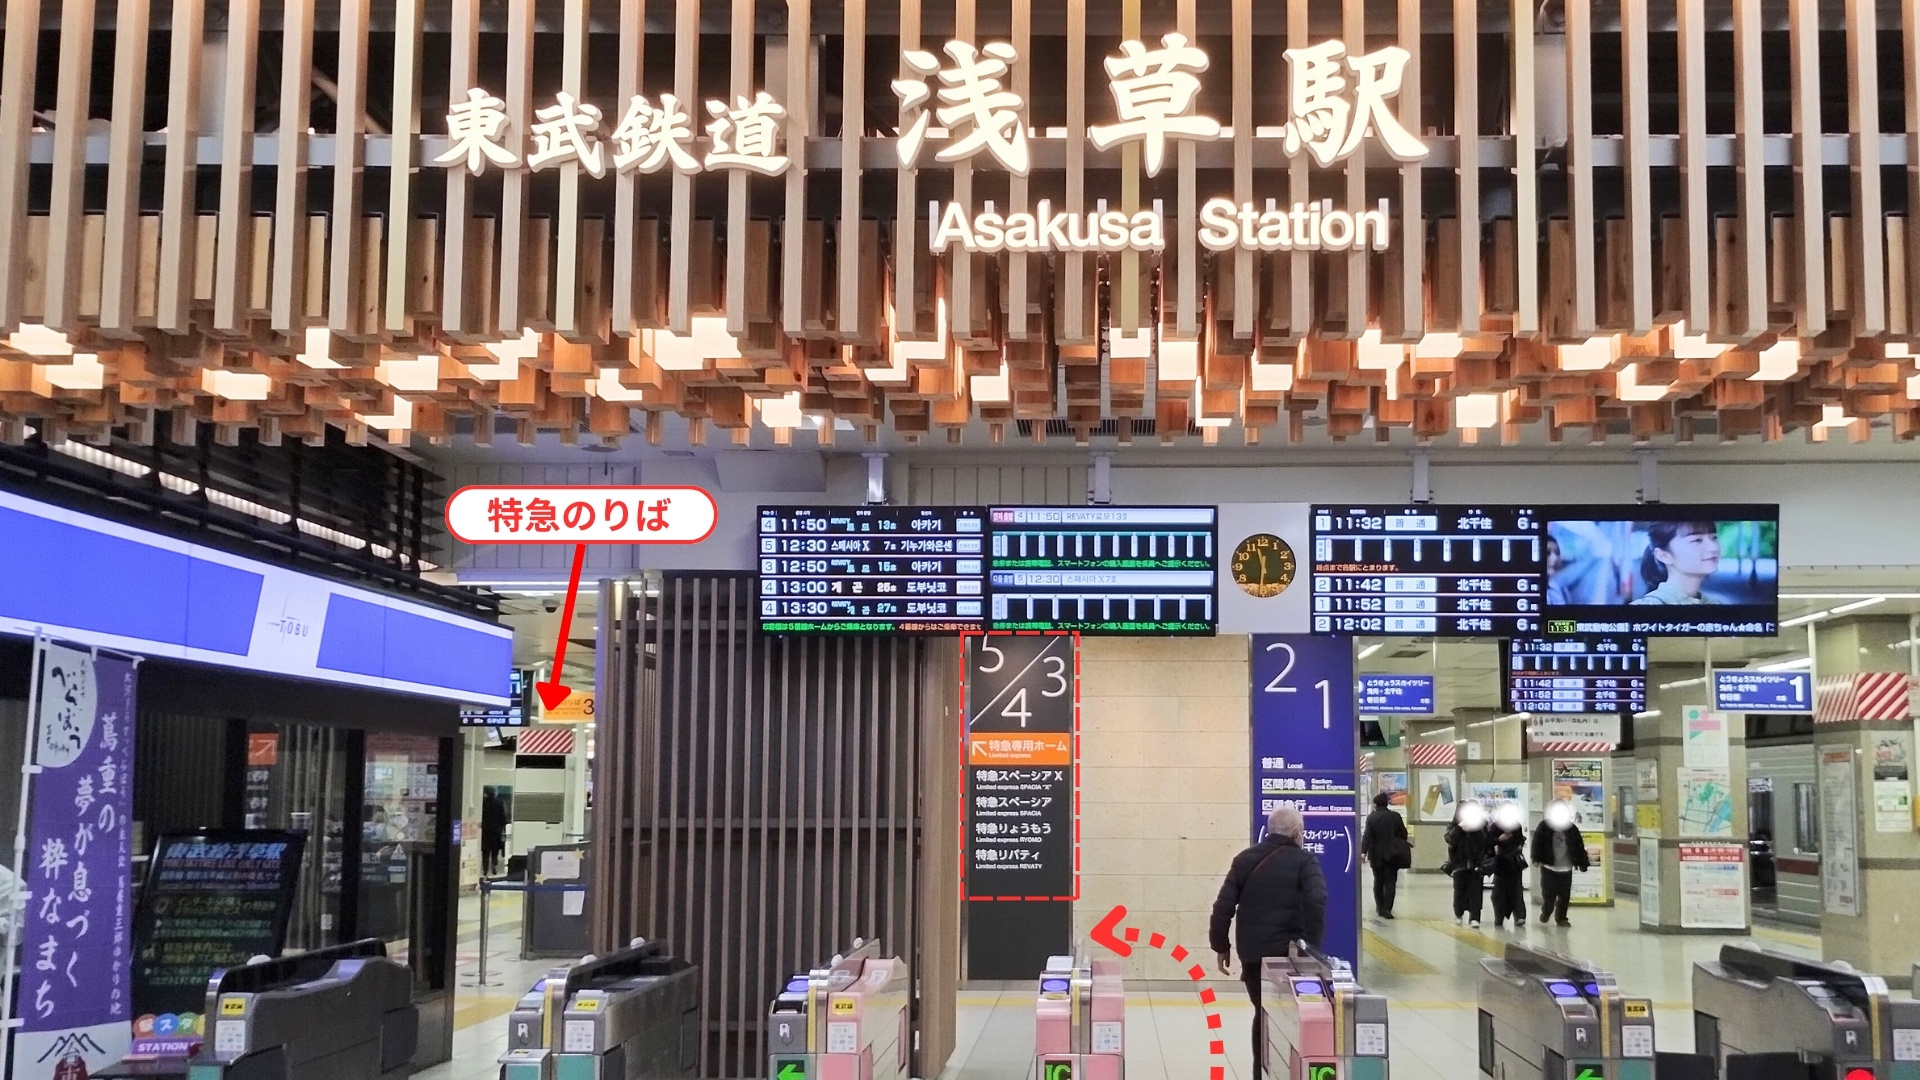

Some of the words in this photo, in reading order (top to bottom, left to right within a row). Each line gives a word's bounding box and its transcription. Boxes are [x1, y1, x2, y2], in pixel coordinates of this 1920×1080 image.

[892, 32, 1430, 177] 浅草駅
[435, 88, 791, 177] 東武鉄道
[931, 200, 1164, 252] Asakusa
[1199, 199, 1389, 252] Station
[1029, 512, 1060, 520] 11:50
[782, 519, 827, 531] 11:50
[911, 519, 941, 531] 아카기
[1336, 517, 1382, 529] 11:32
[1457, 517, 1492, 529] 北千住
[782, 540, 827, 552] 12:30
[1273, 542, 1278, 550] 1
[1239, 552, 1249, 560] 10
[1280, 551, 1288, 559] 2
[782, 560, 827, 573] 12:50
[911, 560, 941, 573] 아카기
[1235, 563, 1243, 571] 9
[1284, 562, 1291, 570] 3
[1029, 575, 1060, 583] 12:30
[1239, 574, 1247, 582] 8
[1280, 574, 1288, 582] 4
[782, 582, 827, 593] 13:00
[906, 582, 947, 593] 도부닛코
[1271, 583, 1279, 591] 5
[1336, 578, 1381, 591] 11:42
[1457, 579, 1492, 591] 北千住
[782, 602, 827, 614] 13:30
[906, 602, 947, 614] 도부닛코
[1336, 598, 1381, 610] 11:52
[1457, 599, 1492, 611] 北千住
[280, 619, 309, 637] TOBU
[1336, 618, 1381, 630] 12:02
[1457, 618, 1492, 631] 北千住
[979, 633, 1004, 673] 5
[1524, 643, 1552, 651] 11:32
[1264, 643, 1297, 692] 2
[1041, 656, 1067, 697] 3
[1789, 676, 1804, 702] 1
[583, 698, 594, 715] 3
[1001, 688, 1032, 728] 4
[1314, 680, 1330, 729] 1
[1523, 702, 1551, 710] 12:02
[989, 740, 1067, 752] 特急専用ホーム
[1262, 757, 1284, 769] 普通
[98, 711, 119, 833] 蔦重の
[976, 769, 1052, 781] 特急スペーシア
[1262, 778, 1306, 790] 区間準急
[976, 796, 1052, 808] 特急スペーシア
[976, 822, 1051, 834] 特急りょうもう
[976, 849, 1039, 861] 特急リバティ
[66, 774, 95, 988] 夢が息づく
[35, 838, 68, 1018] 粋なまち
[138, 1042, 188, 1052] STATION
[1045, 1064, 1071, 1080] IC
[1310, 1067, 1335, 1080] IC
